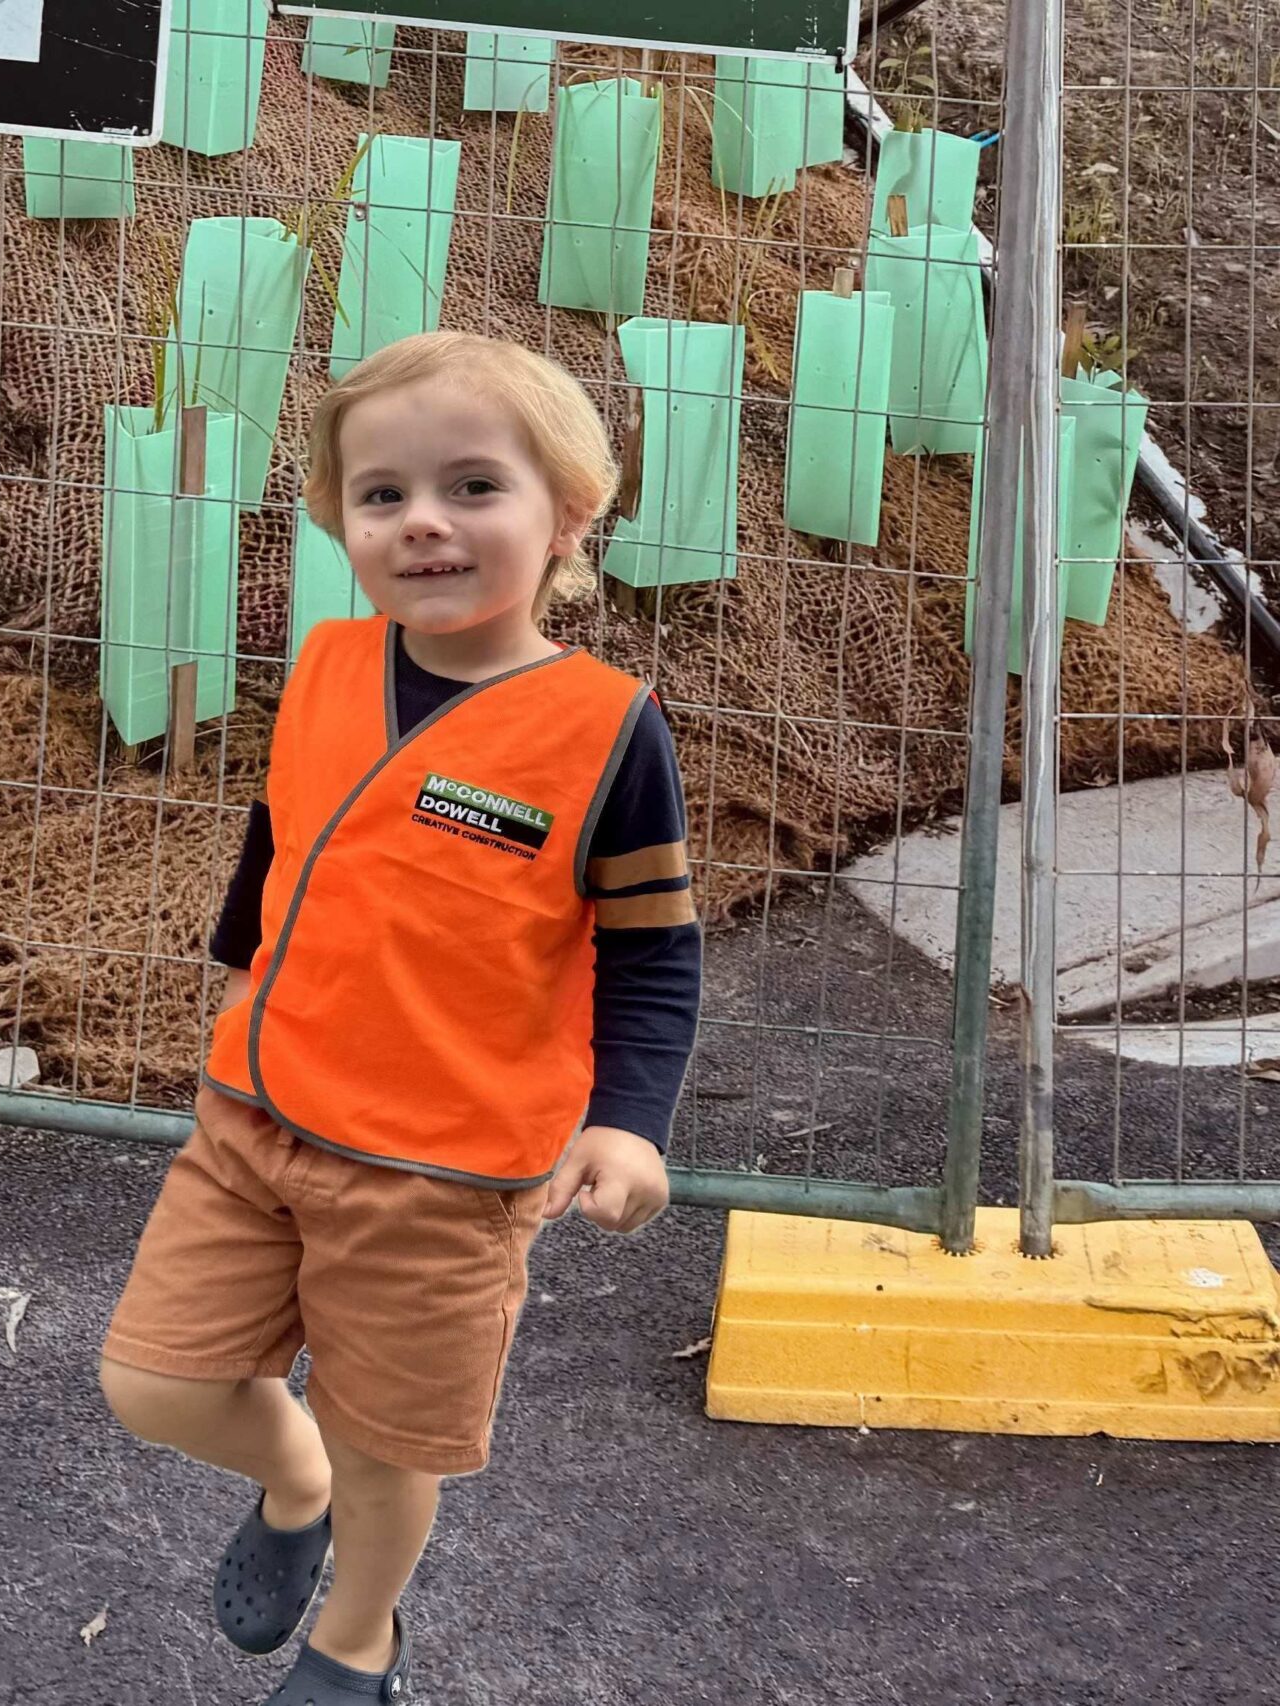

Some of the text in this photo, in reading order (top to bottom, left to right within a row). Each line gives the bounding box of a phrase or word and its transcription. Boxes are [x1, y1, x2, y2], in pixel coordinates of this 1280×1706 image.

[420, 795, 502, 832] DOWELL
[411, 814, 536, 861] CREATIVE CONSTRUCTION
